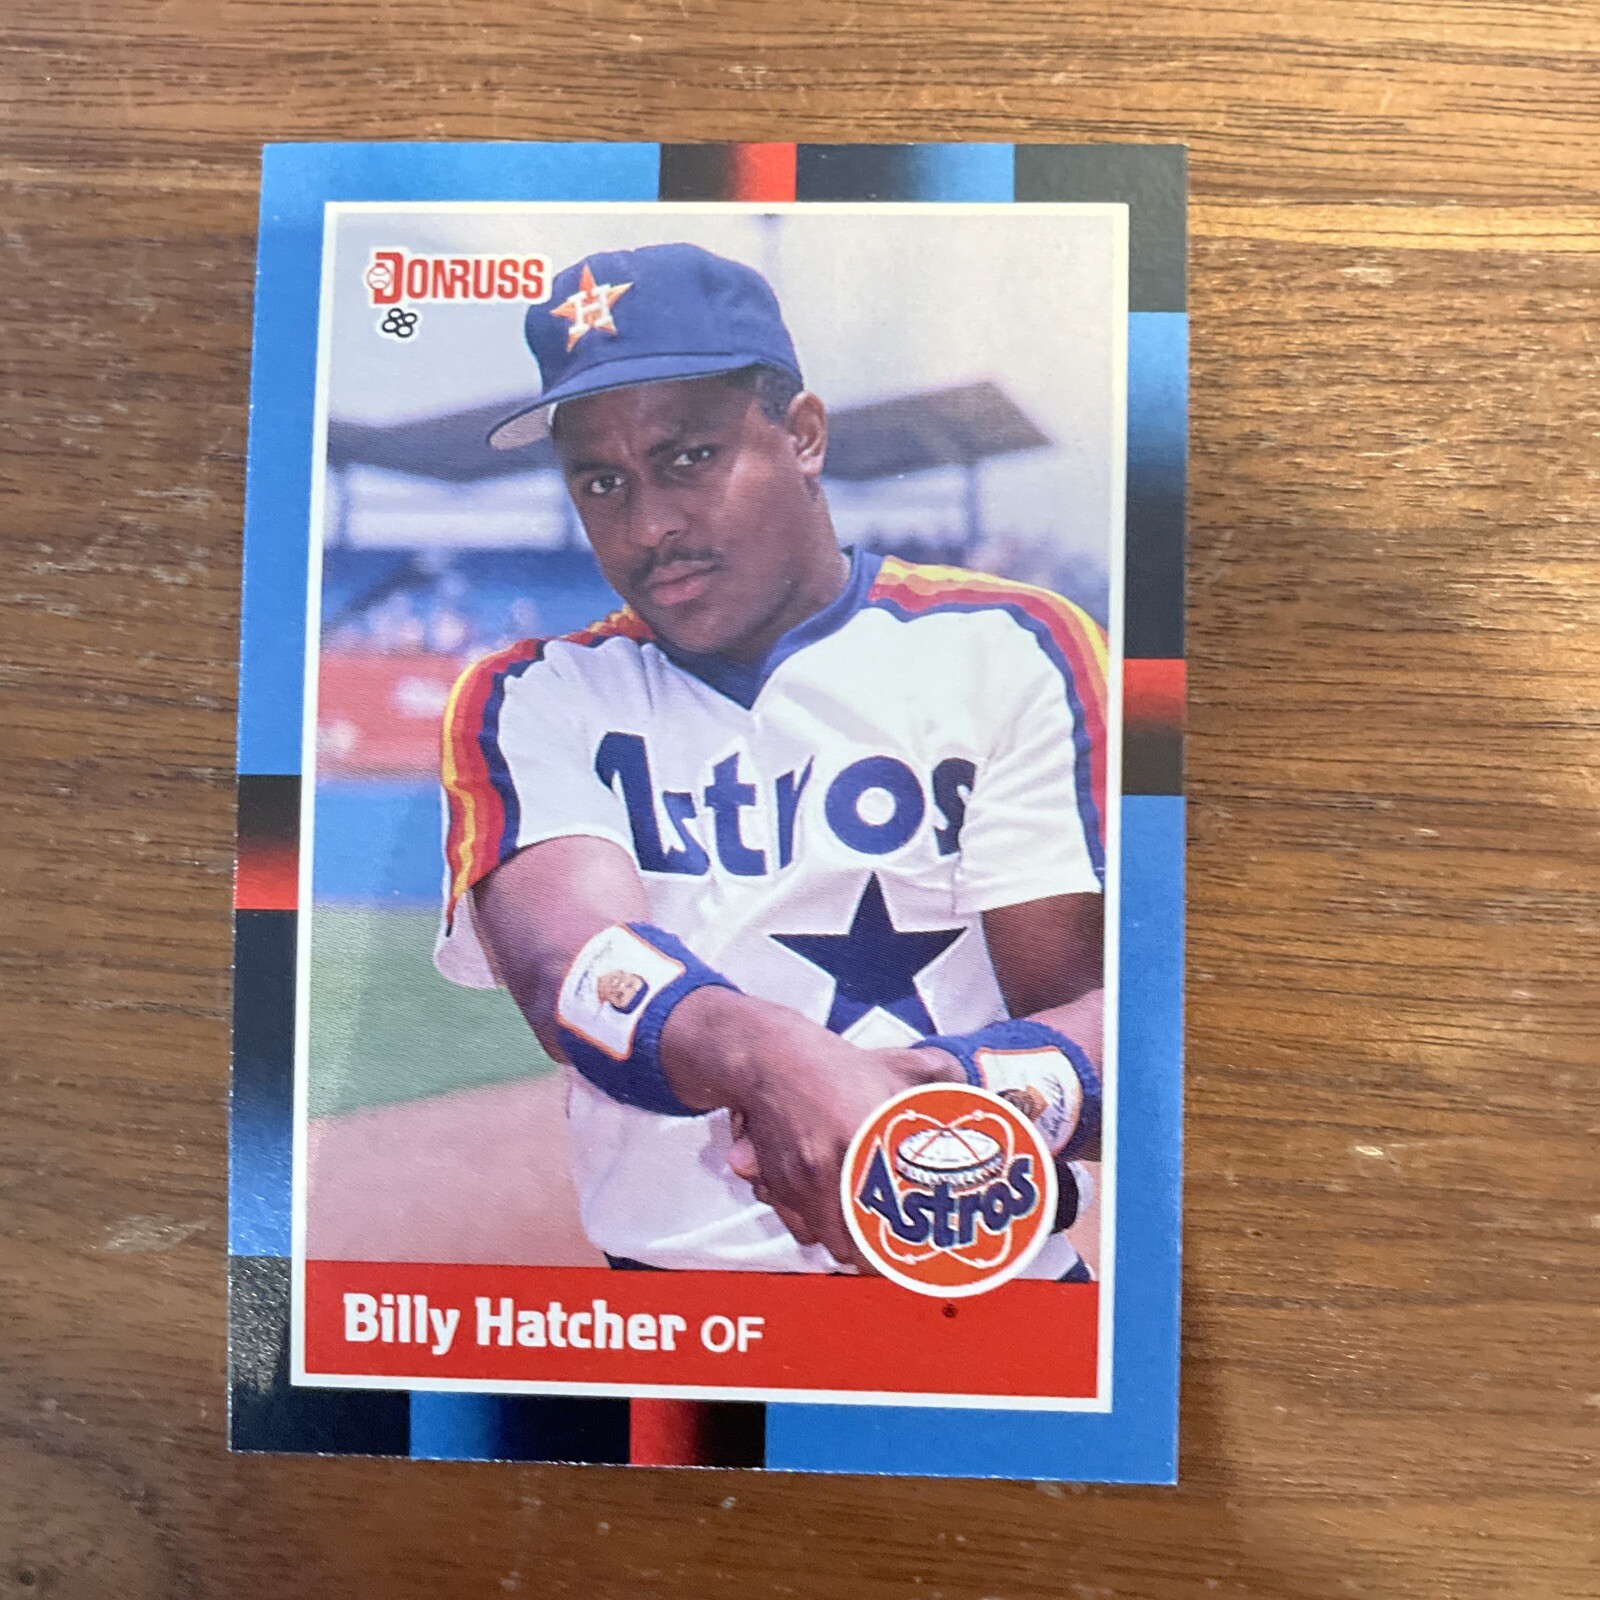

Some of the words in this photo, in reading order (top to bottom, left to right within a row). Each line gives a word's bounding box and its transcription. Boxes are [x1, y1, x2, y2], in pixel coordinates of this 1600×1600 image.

[366, 251, 545, 305] DONRUSS
[567, 283, 614, 335] H
[857, 1142, 1038, 1249] Astros
[343, 1292, 460, 1355] Billy
[475, 1296, 687, 1352] Hatcher
[700, 1315, 766, 1353] OF
